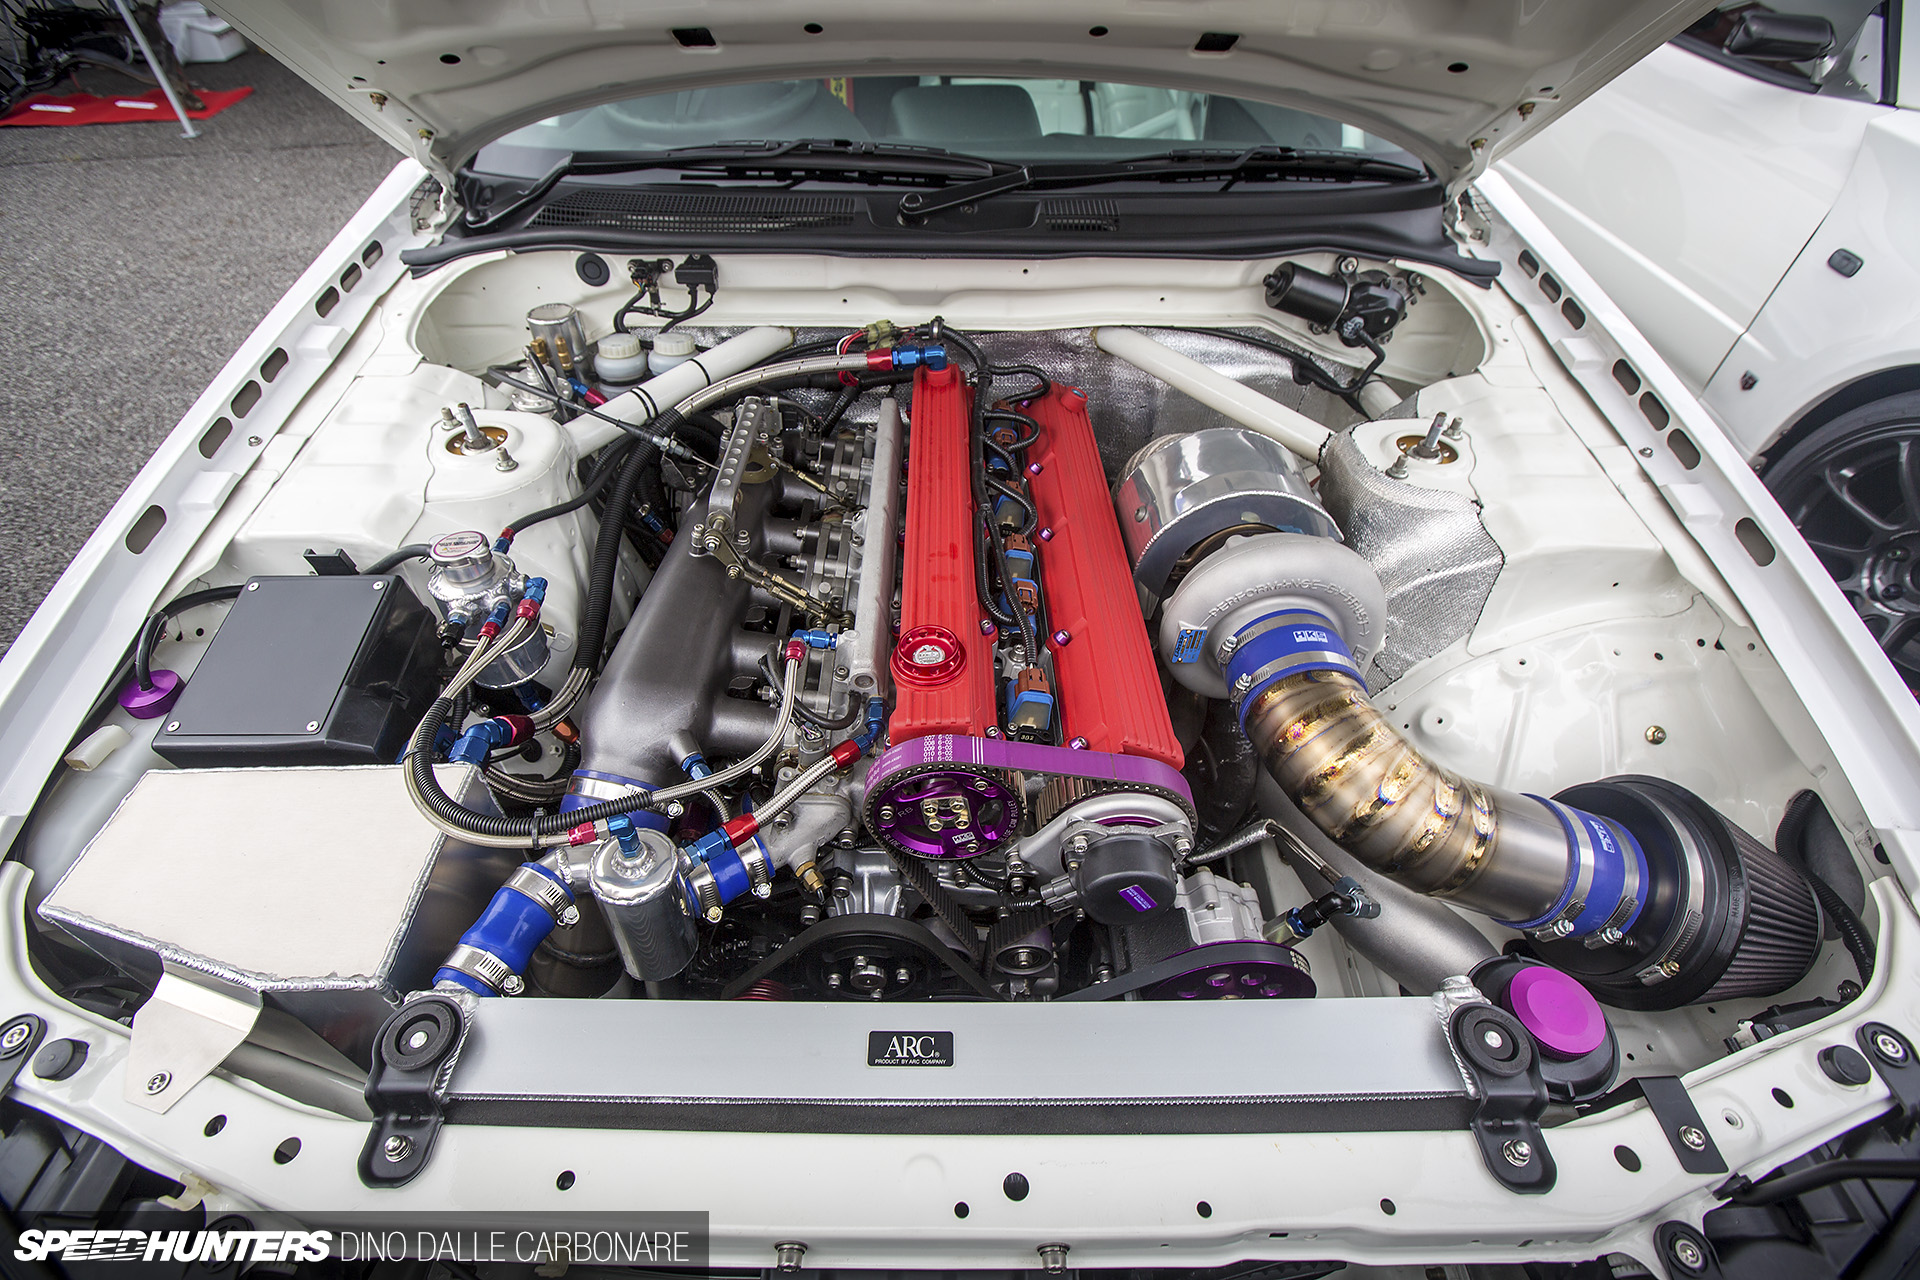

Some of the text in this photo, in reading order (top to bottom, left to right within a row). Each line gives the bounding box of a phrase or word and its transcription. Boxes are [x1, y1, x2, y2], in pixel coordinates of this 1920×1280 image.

[1208, 578, 1321, 617] PERFORMANCE
[1293, 630, 1328, 643] HKS
[883, 1035, 935, 1059] ARC
